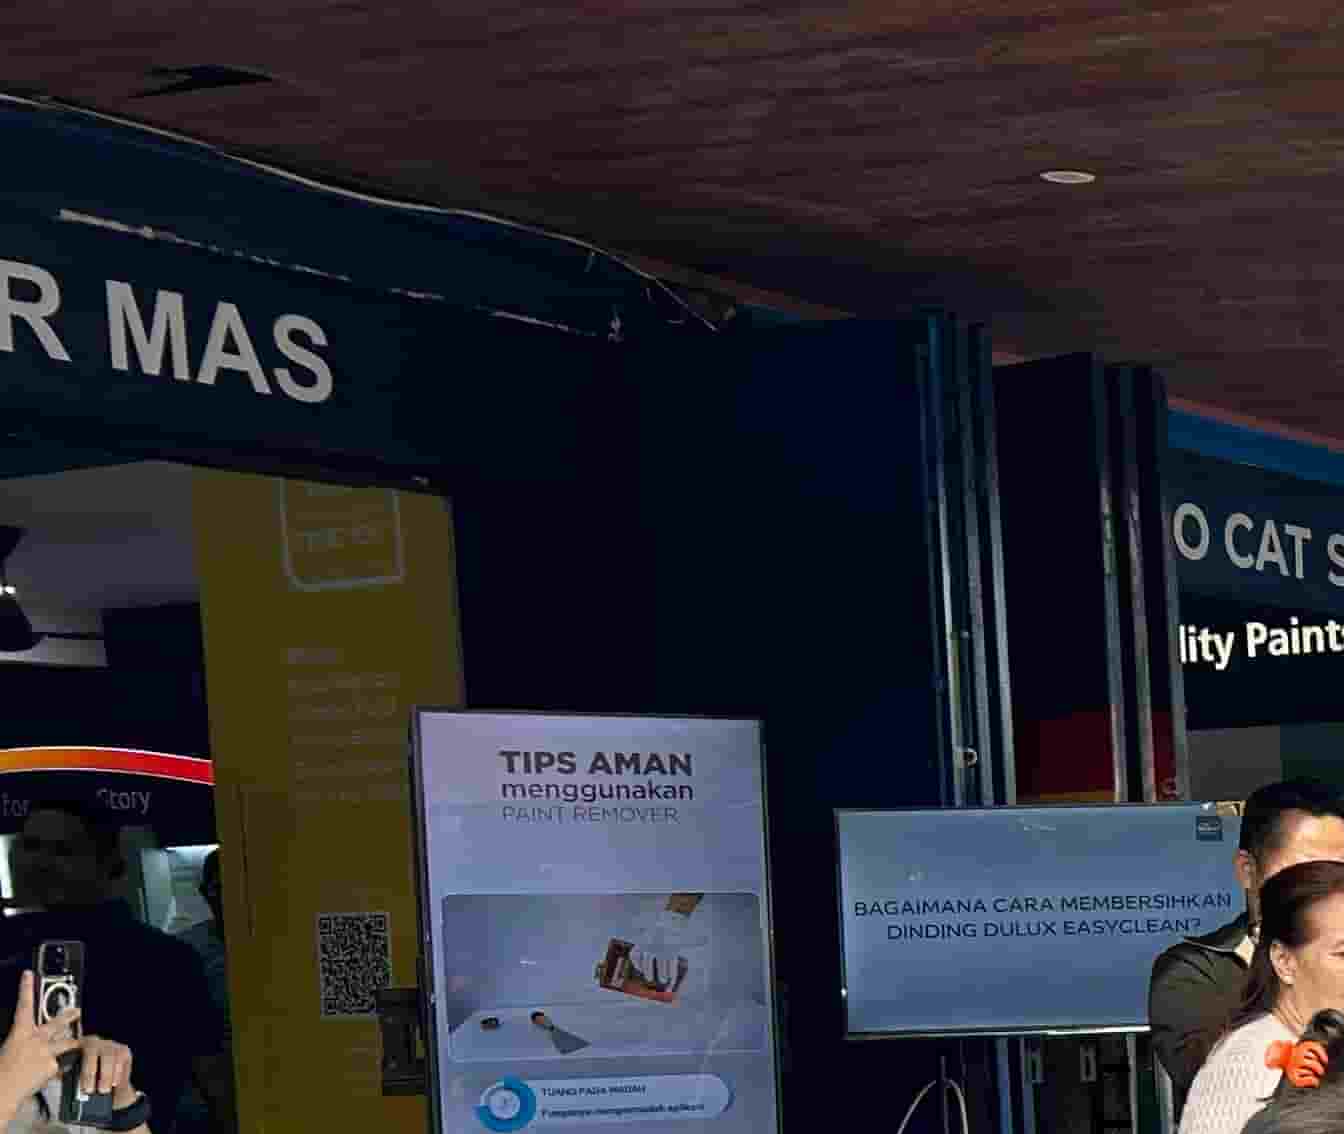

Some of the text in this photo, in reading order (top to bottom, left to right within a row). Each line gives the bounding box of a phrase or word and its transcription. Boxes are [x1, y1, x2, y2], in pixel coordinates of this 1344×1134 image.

[105, 279, 333, 404] MAS
[1173, 503, 1210, 561] O
[1224, 512, 1313, 580] CAT
[1178, 623, 1234, 671] lity
[499, 750, 693, 777] TIPS AMAN
[501, 780, 694, 803] menggunakan
[503, 805, 680, 825] PAINT REMOVER
[854, 892, 1232, 917] BAGAIMANA CARA MEMBERSIHKAN
[887, 917, 1202, 941] DINDING DULUX EASYCLEAN?
